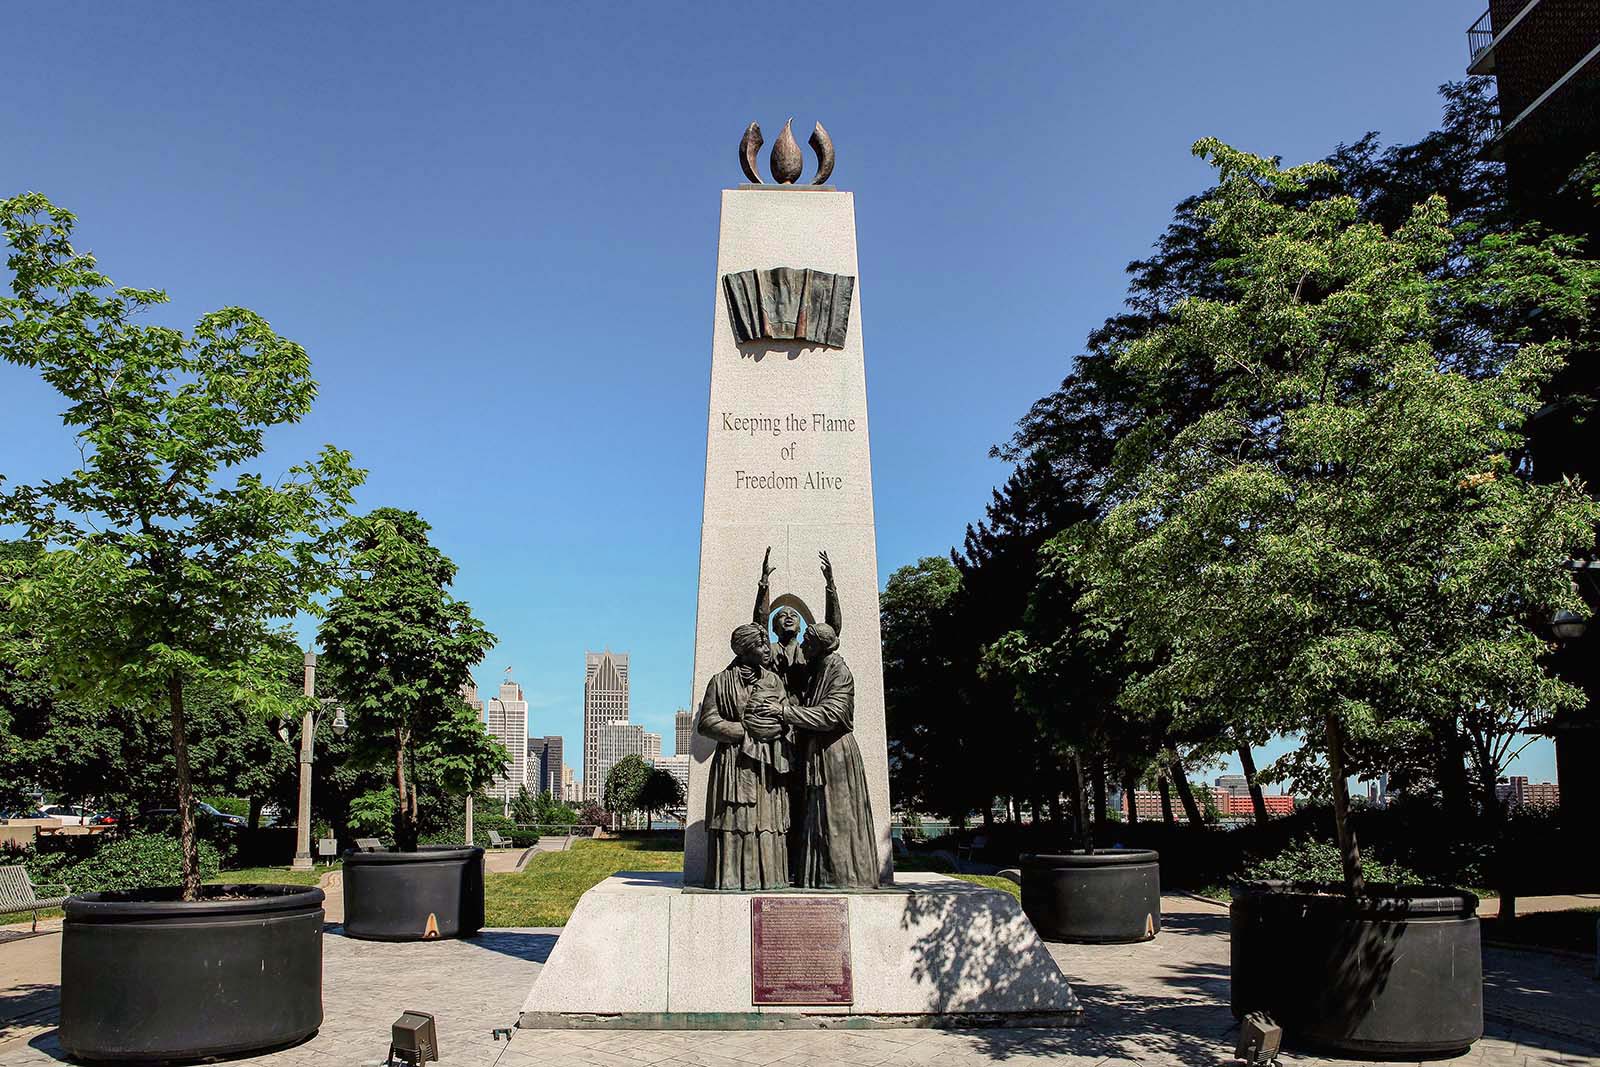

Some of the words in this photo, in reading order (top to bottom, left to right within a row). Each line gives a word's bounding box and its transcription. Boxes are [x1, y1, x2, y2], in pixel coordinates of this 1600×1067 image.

[721, 412, 781, 437] Keeping
[785, 413, 807, 432] the
[812, 413, 856, 432] Flame
[780, 441, 797, 461] of
[735, 470, 798, 490] Freedom
[803, 471, 843, 490] Alive
